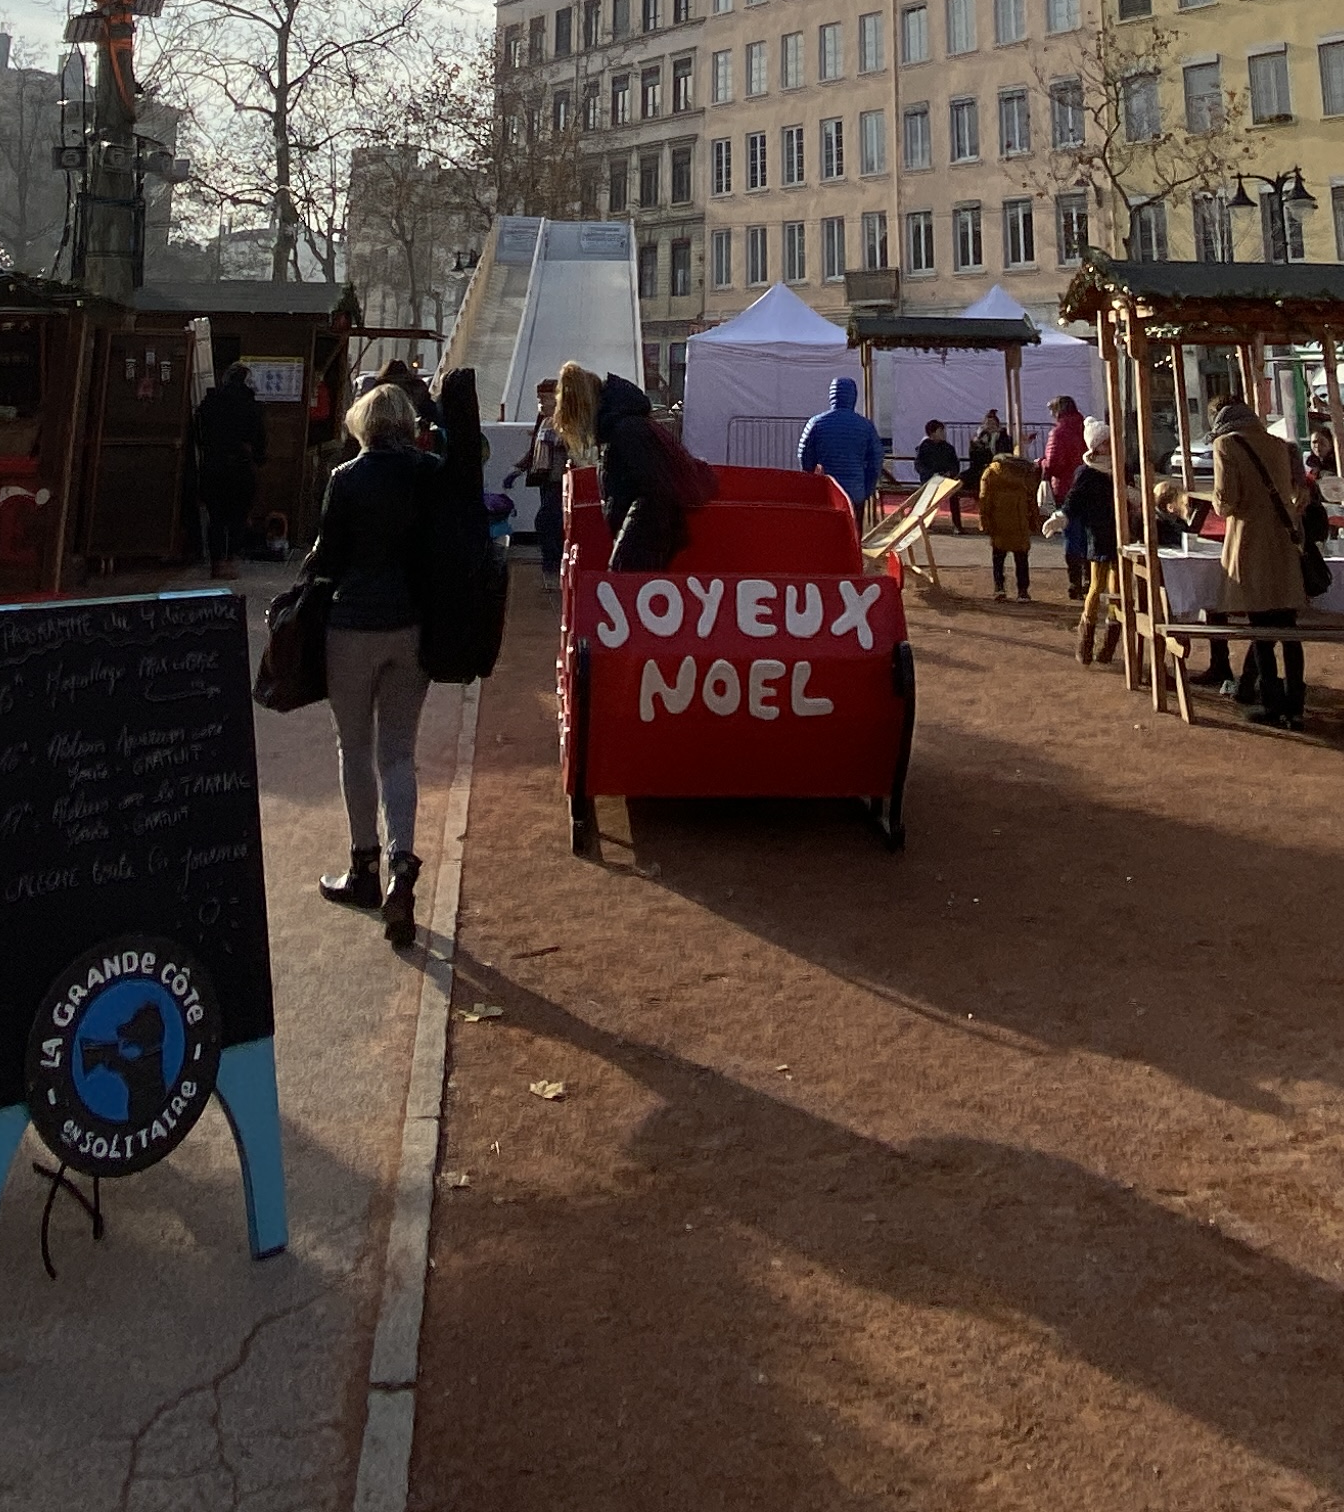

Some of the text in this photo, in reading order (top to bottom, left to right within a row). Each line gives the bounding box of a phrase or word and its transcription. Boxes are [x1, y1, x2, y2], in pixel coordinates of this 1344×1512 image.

[596, 576, 881, 650] JOYEUX
[639, 655, 834, 722] NOEL
[40, 1036, 65, 1070] LA
